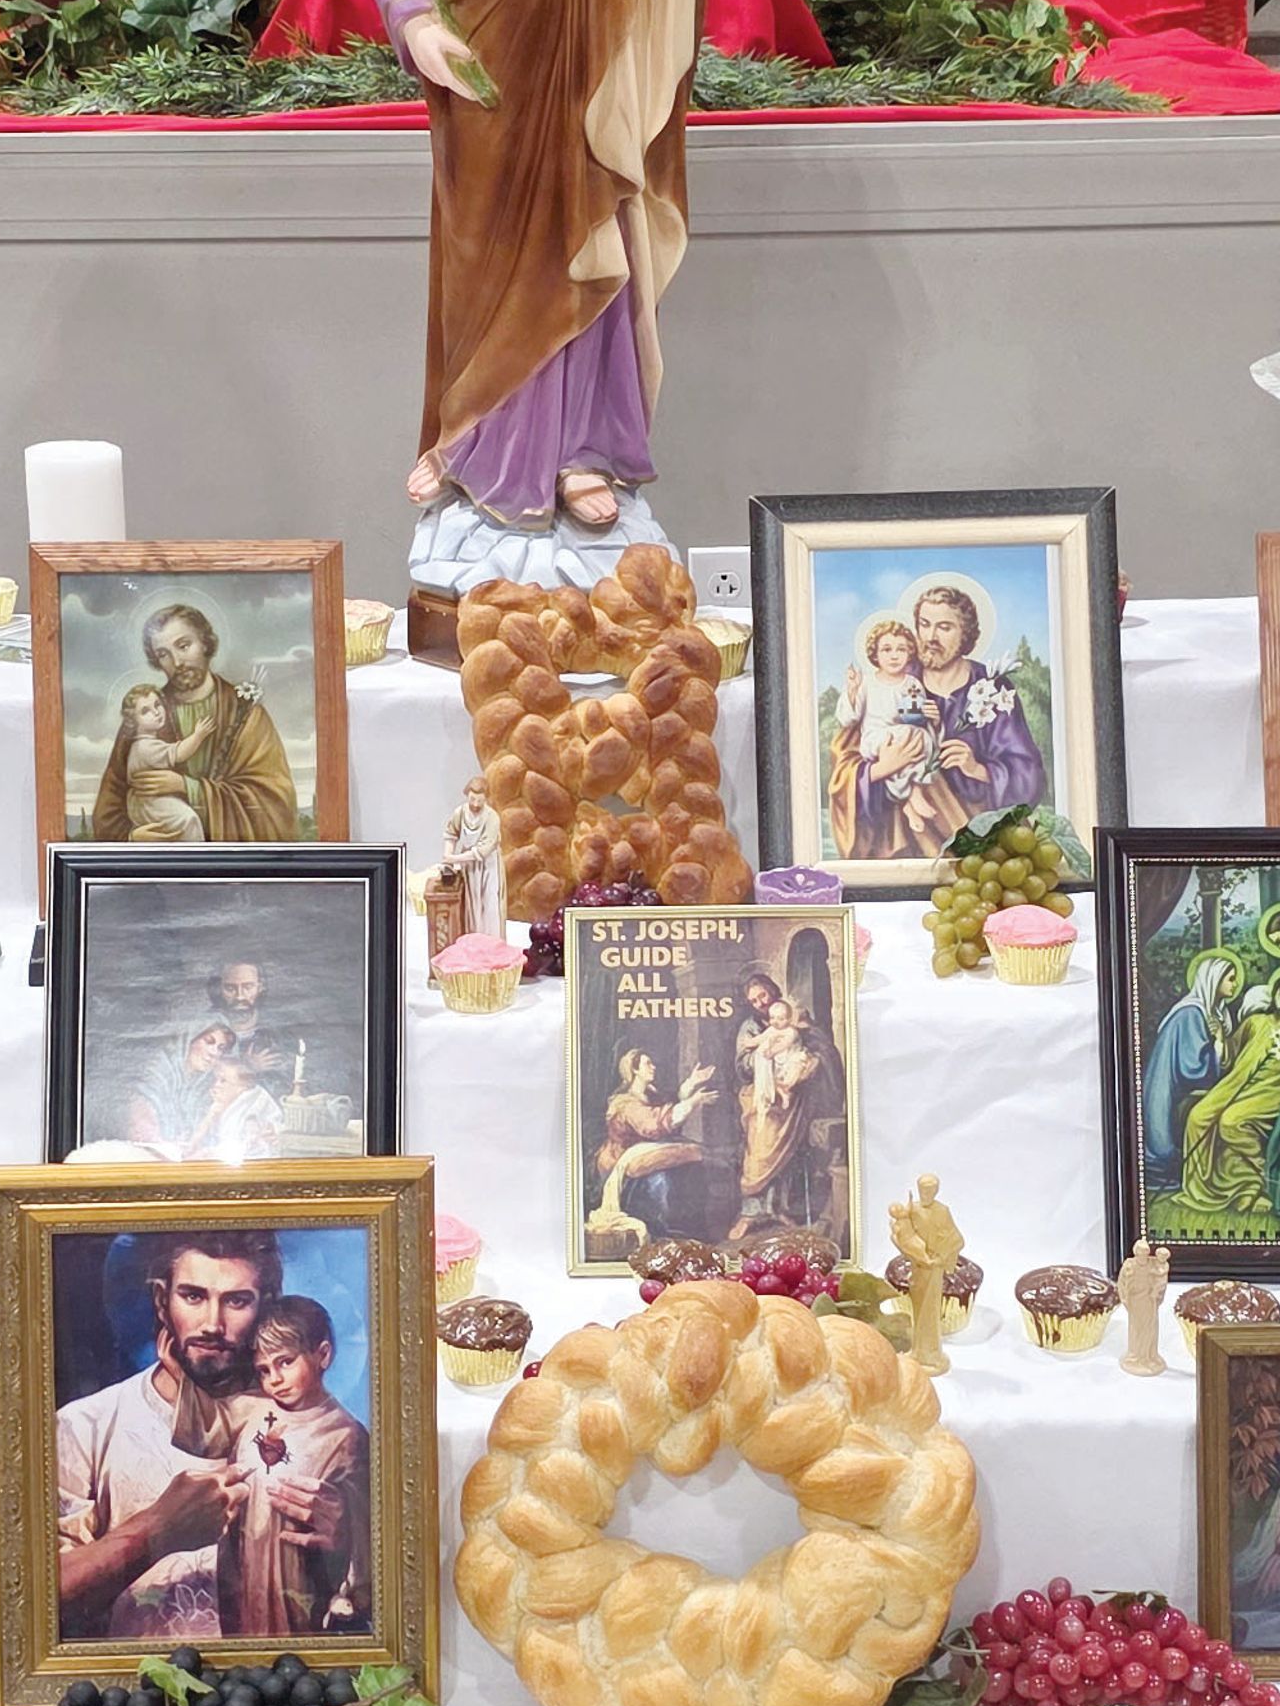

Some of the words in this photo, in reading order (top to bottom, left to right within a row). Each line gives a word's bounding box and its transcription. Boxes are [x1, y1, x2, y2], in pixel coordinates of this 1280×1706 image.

[592, 921, 627, 942] ST.
[634, 919, 745, 943] JOSEPH,
[600, 946, 688, 967] GUIDE
[617, 972, 668, 993] ALL
[618, 997, 734, 1019] FATHERS
